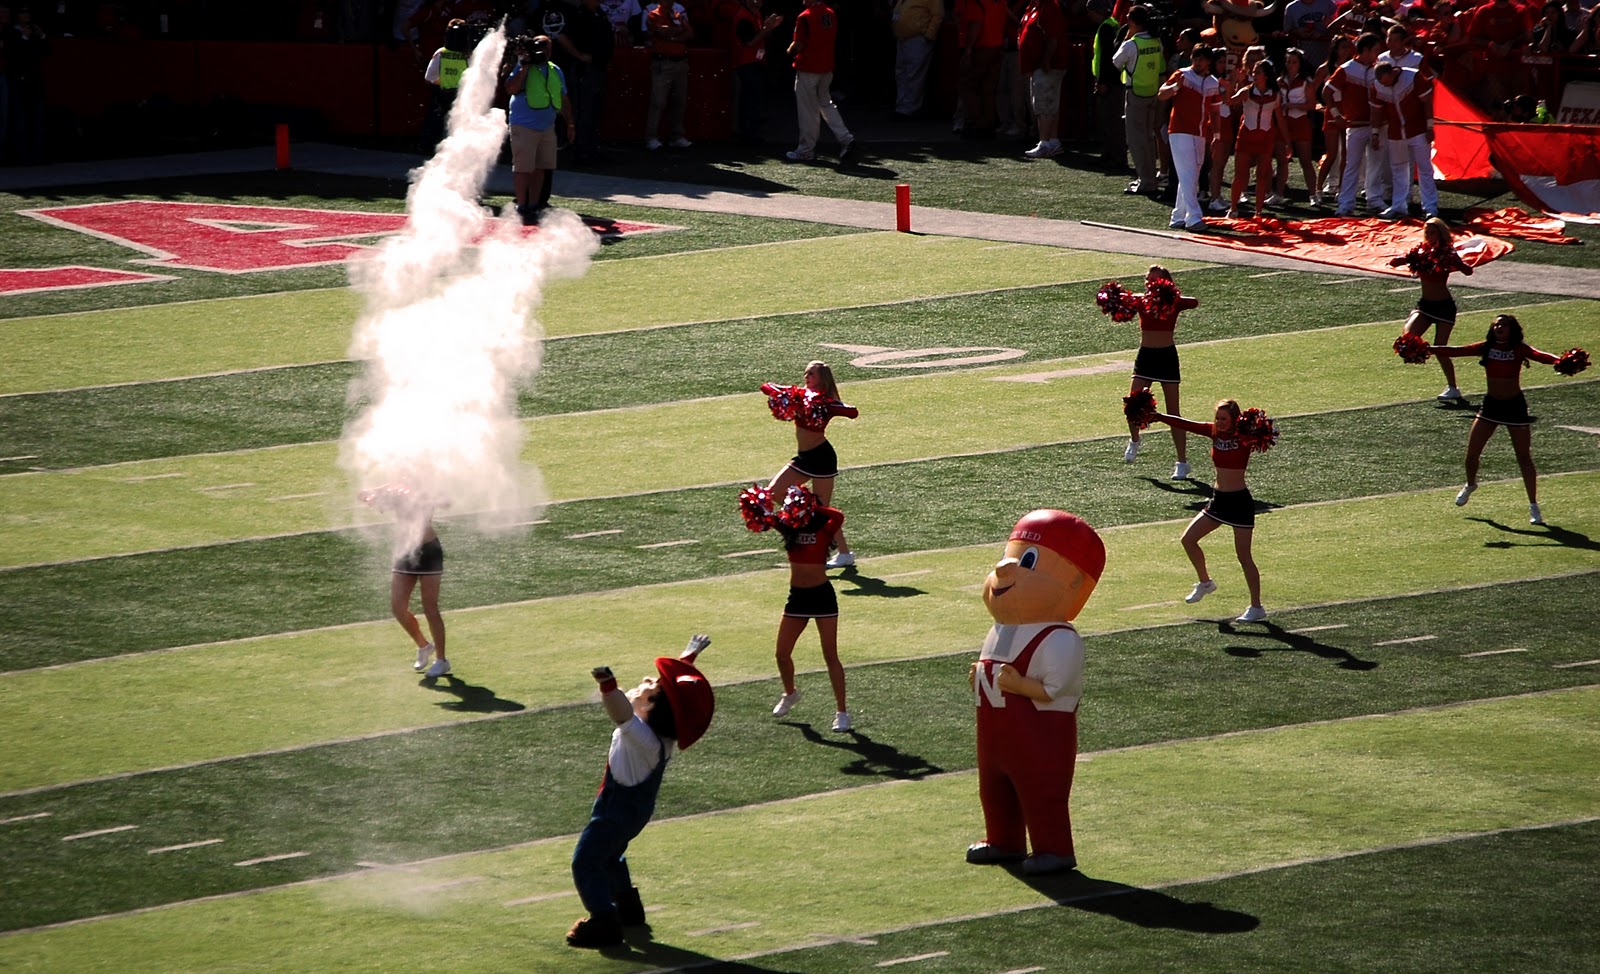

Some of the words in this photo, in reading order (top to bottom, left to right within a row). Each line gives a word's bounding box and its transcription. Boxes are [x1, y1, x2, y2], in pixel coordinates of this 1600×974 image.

[1139, 46, 1160, 55] MEDIA
[1020, 530, 1041, 542] RED
[974, 660, 1006, 709] N
